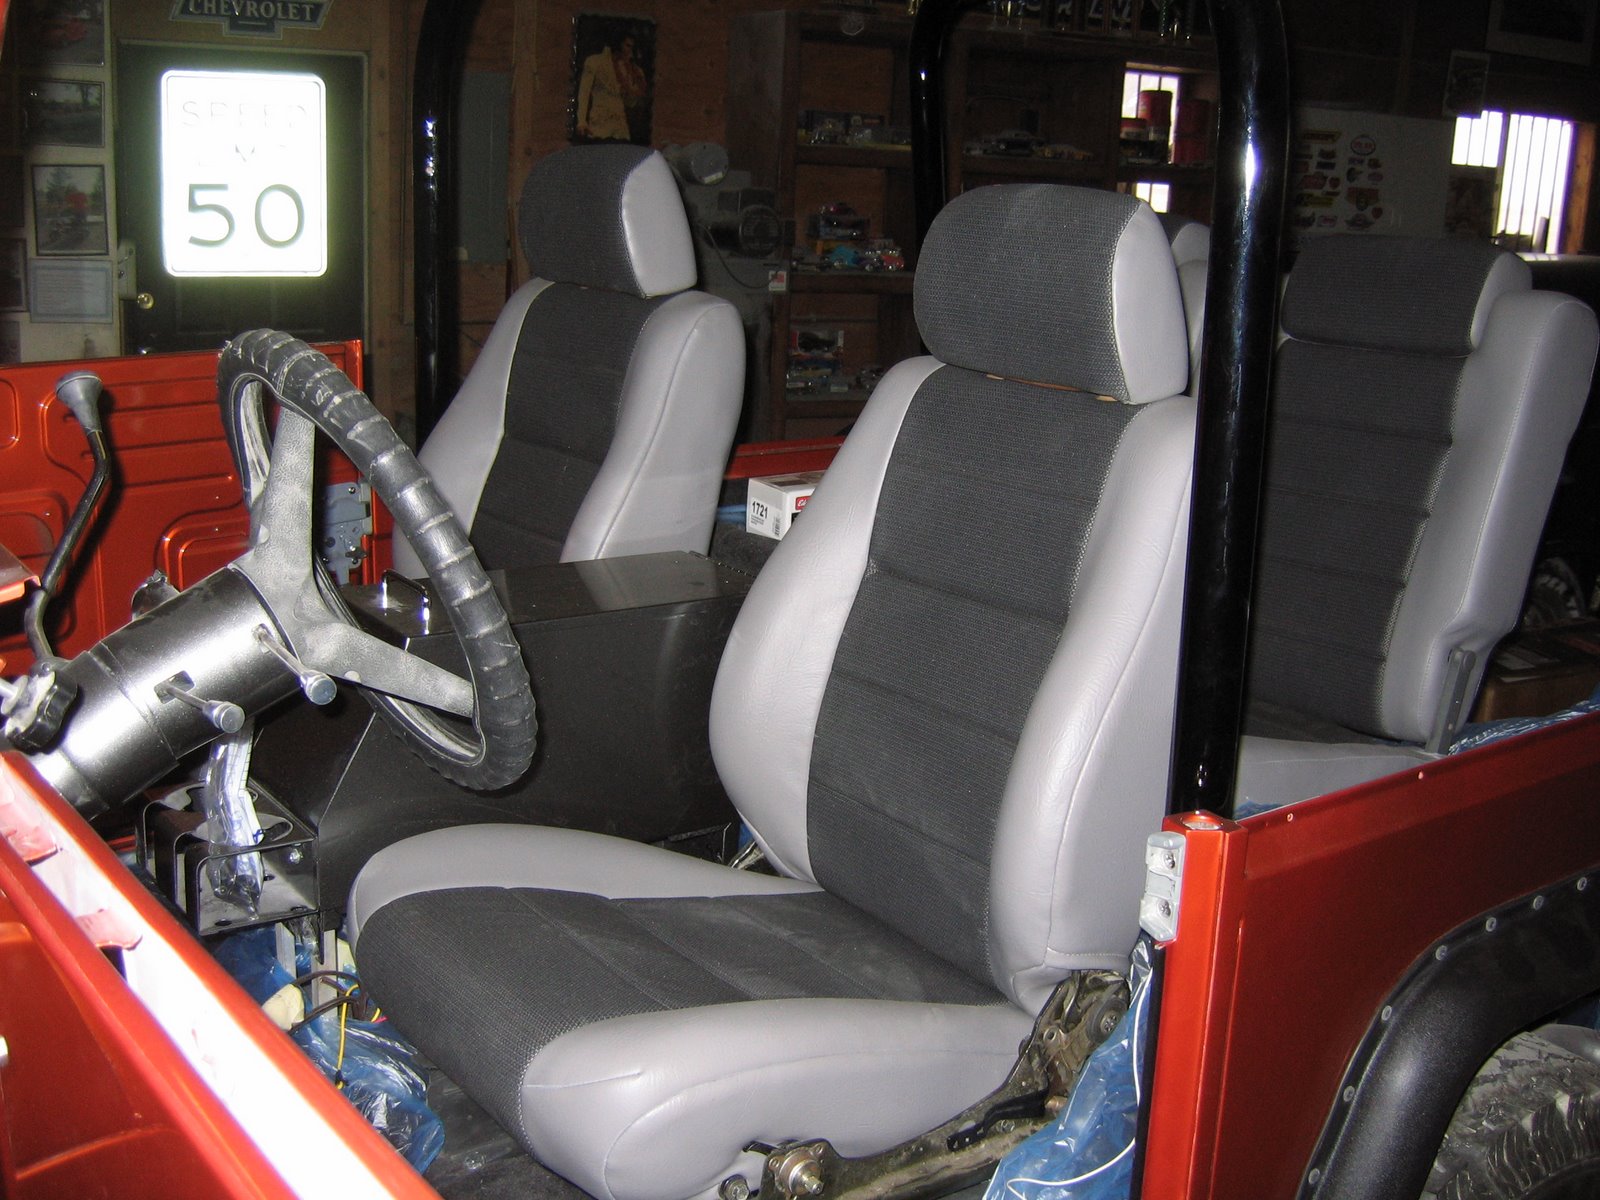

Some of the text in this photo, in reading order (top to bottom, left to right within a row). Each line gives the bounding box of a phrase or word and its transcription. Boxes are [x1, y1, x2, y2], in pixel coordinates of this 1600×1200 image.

[190, 0, 314, 20] CHEVROLET
[189, 184, 304, 248] 50
[751, 501, 768, 519] 1721
